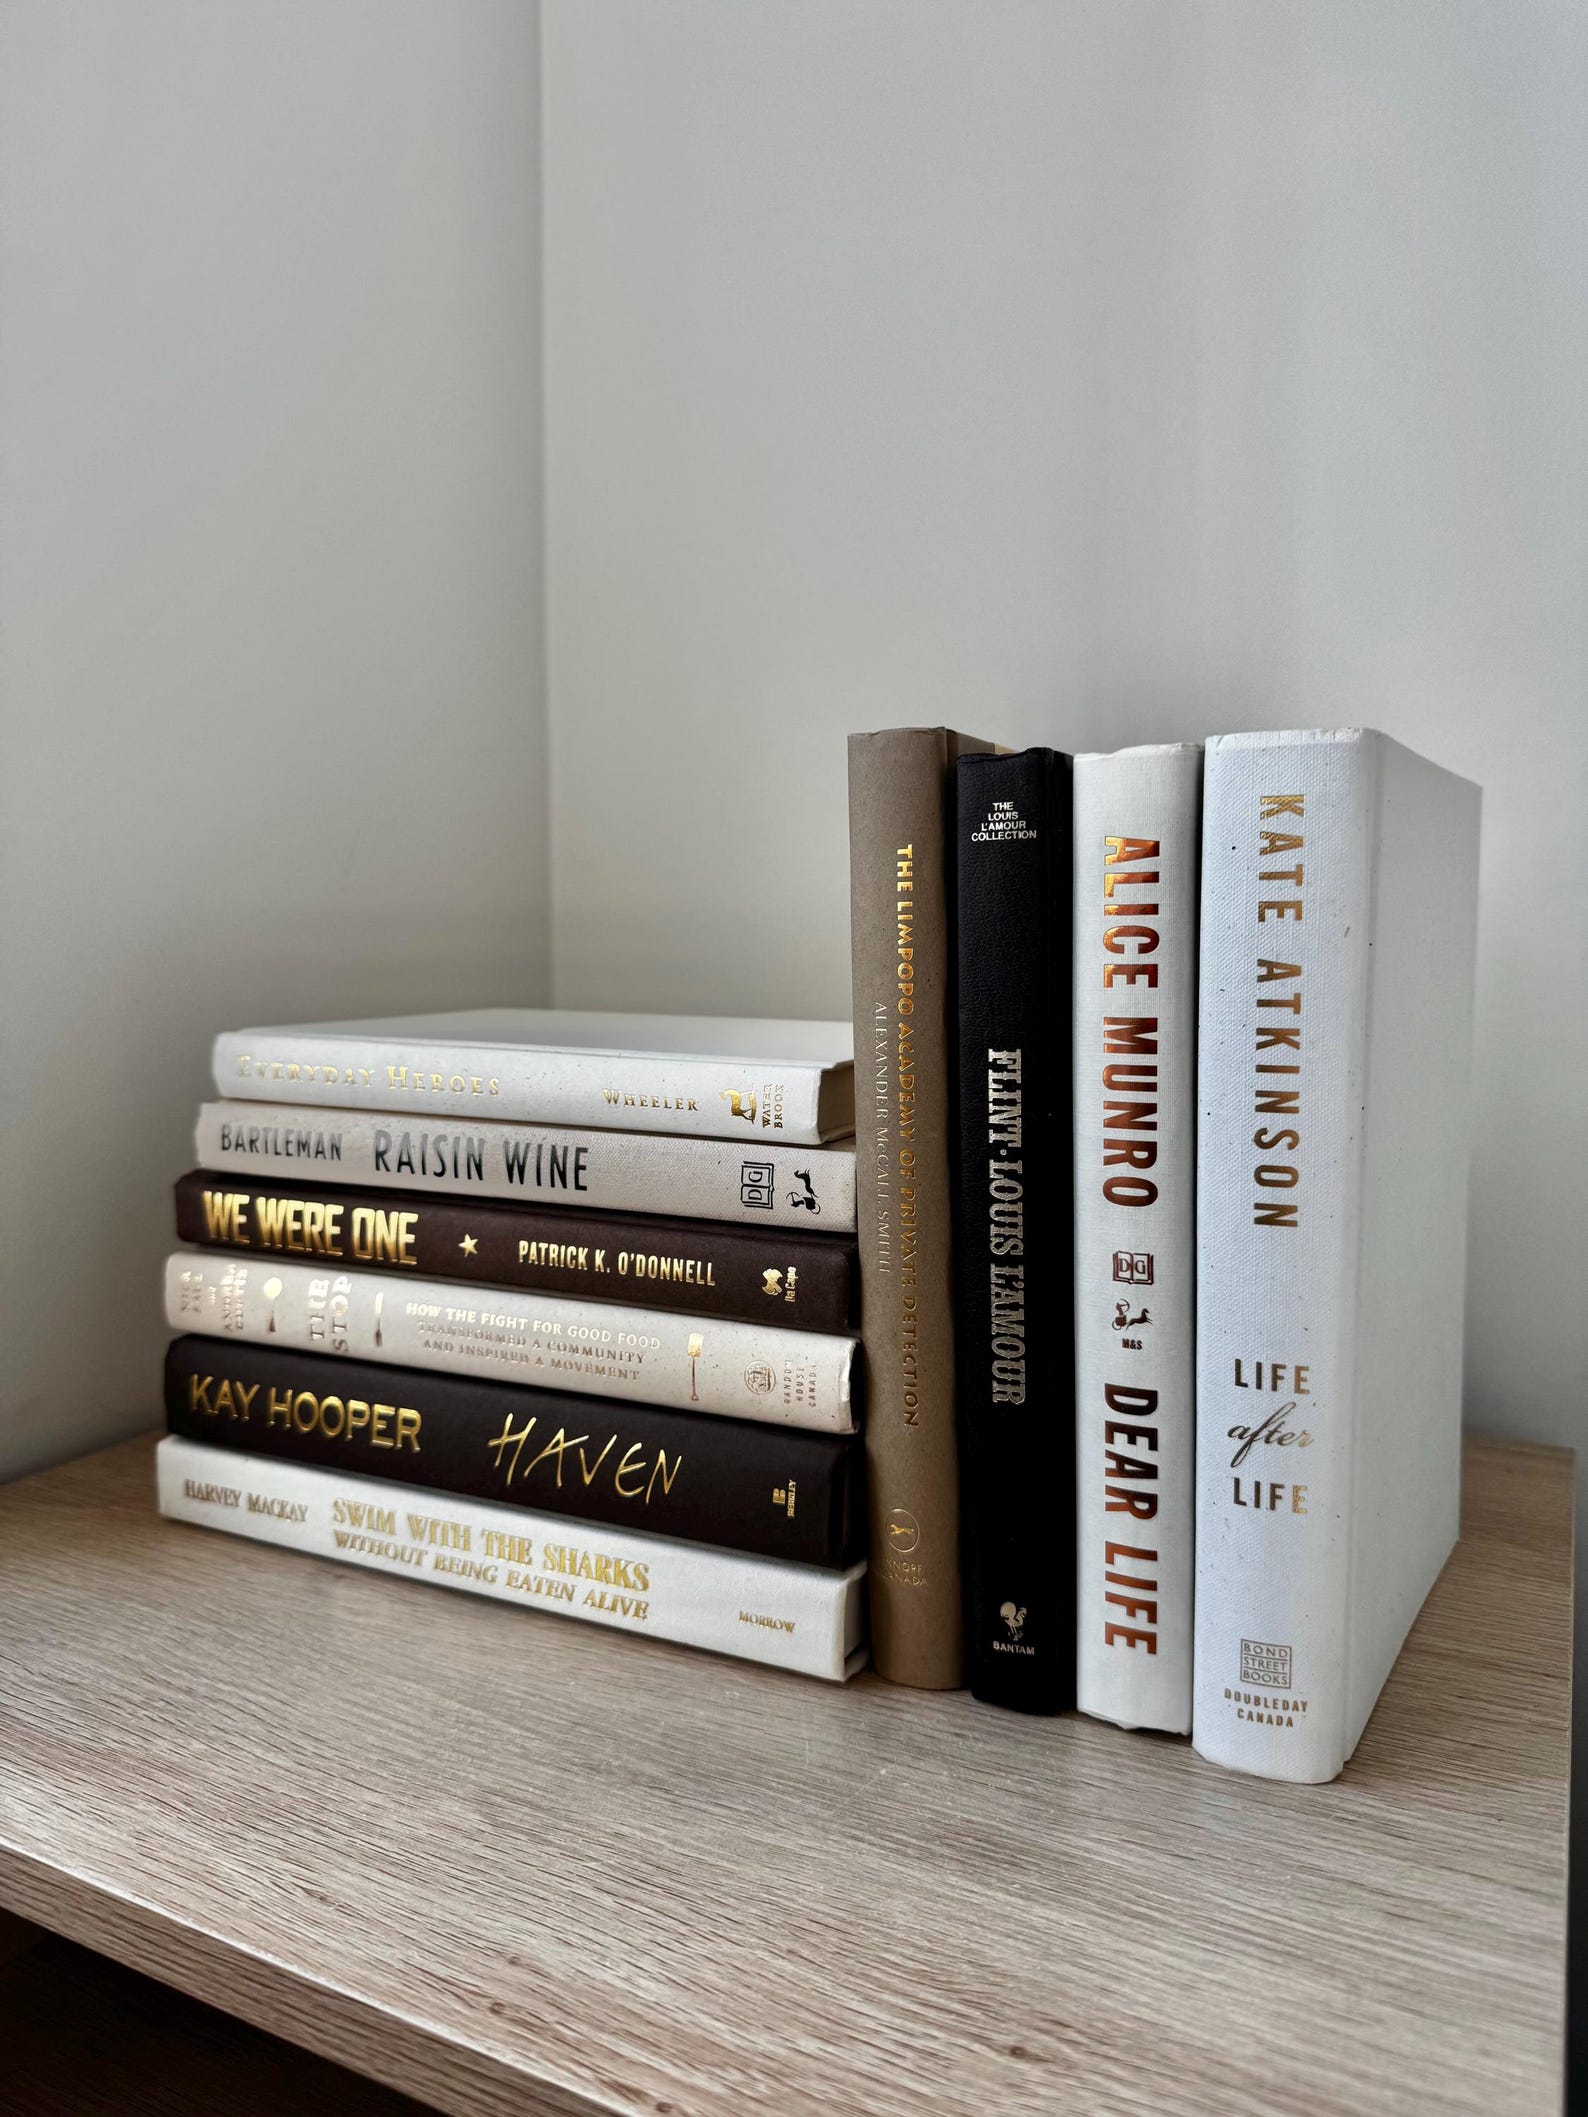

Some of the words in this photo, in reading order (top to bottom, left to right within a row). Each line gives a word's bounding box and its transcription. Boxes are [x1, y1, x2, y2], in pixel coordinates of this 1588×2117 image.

[981, 820, 1026, 831] L'AMOUR
[988, 811, 1019, 821] LOUIS
[992, 801, 1014, 811] THE
[971, 830, 1037, 842] COLLECTION
[1256, 793, 1305, 923] KATE
[896, 843, 913, 892] THE
[1102, 834, 1160, 988] ALICE
[897, 901, 914, 1015] LIMPOPO
[874, 1001, 889, 1119] ALEXANDER
[898, 1022, 916, 1143] ACADEMY
[761, 1082, 772, 1129] WATER
[773, 1083, 785, 1130] BROOK
[988, 1048, 1022, 1147] FLINT
[1102, 1016, 1159, 1209] MUNRO
[1253, 958, 1302, 1228] ATKINSON
[220, 1123, 343, 1162] BARTLEMAN
[373, 1129, 485, 1182] RAISIN
[503, 1140, 589, 1192] WINE
[899, 1149, 916, 1180] OF
[202, 1190, 250, 1245] WE
[255, 1196, 345, 1257] WERE
[351, 1207, 419, 1266] ONE
[989, 1159, 1023, 1256] LOUIS
[877, 1209, 891, 1274] SMITH
[900, 1187, 917, 1287] PRIVATE
[518, 1240, 590, 1273] PATRICK
[594, 1250, 611, 1275] K.
[617, 1251, 717, 1287] O'DONNELL
[784, 1266, 798, 1289] Capo
[330, 1274, 352, 1352] STOP
[406, 1302, 442, 1318] HOW
[447, 1307, 477, 1324] THE
[480, 1313, 529, 1331] FIGHT
[532, 1319, 562, 1336] FOR
[567, 1325, 612, 1343] GOOD
[617, 1332, 661, 1350] FOOD
[990, 1262, 1026, 1405] L'AMOUR
[418, 1320, 527, 1347] TRANSFORMED
[532, 1338, 542, 1349] A
[546, 1339, 646, 1364] COMMUNITY
[423, 1338, 454, 1352] AND
[458, 1343, 530, 1366] INSPIRED
[535, 1356, 545, 1367] A
[550, 1357, 641, 1381] MOVEMENT
[902, 1296, 919, 1427] DETECTION
[1121, 1338, 1143, 1350] M&S
[796, 1366, 805, 1402] HOUSE
[1234, 1357, 1310, 1395] LIFE
[188, 1373, 261, 1421] KAY
[266, 1386, 422, 1452] HOOPER
[487, 1412, 683, 1505] HAVEN
[1104, 1381, 1159, 1521] DEAR
[1227, 1401, 1313, 1469] after
[184, 1478, 242, 1511] HARVEY
[247, 1492, 309, 1523] MACKAY
[1232, 1476, 1309, 1515] LIFE
[332, 1497, 396, 1536] SWIM
[406, 1513, 473, 1553] WITH
[481, 1528, 532, 1566] THE
[543, 1542, 650, 1593] SHARKS
[332, 1529, 428, 1566] WITHOUT
[432, 1554, 499, 1584] BEING
[506, 1569, 577, 1603] EATEN
[584, 1586, 650, 1621] ALIVE
[1104, 1540, 1158, 1656] LIFE
[992, 1640, 1035, 1656] BANTAM
[1243, 1643, 1288, 1658] BOND
[1243, 1656, 1288, 1671] STREET
[1224, 1688, 1308, 1712] DOUBLEDAY
[1243, 1669, 1288, 1685] BOOKS
[1237, 1708, 1293, 1728] CANADA
